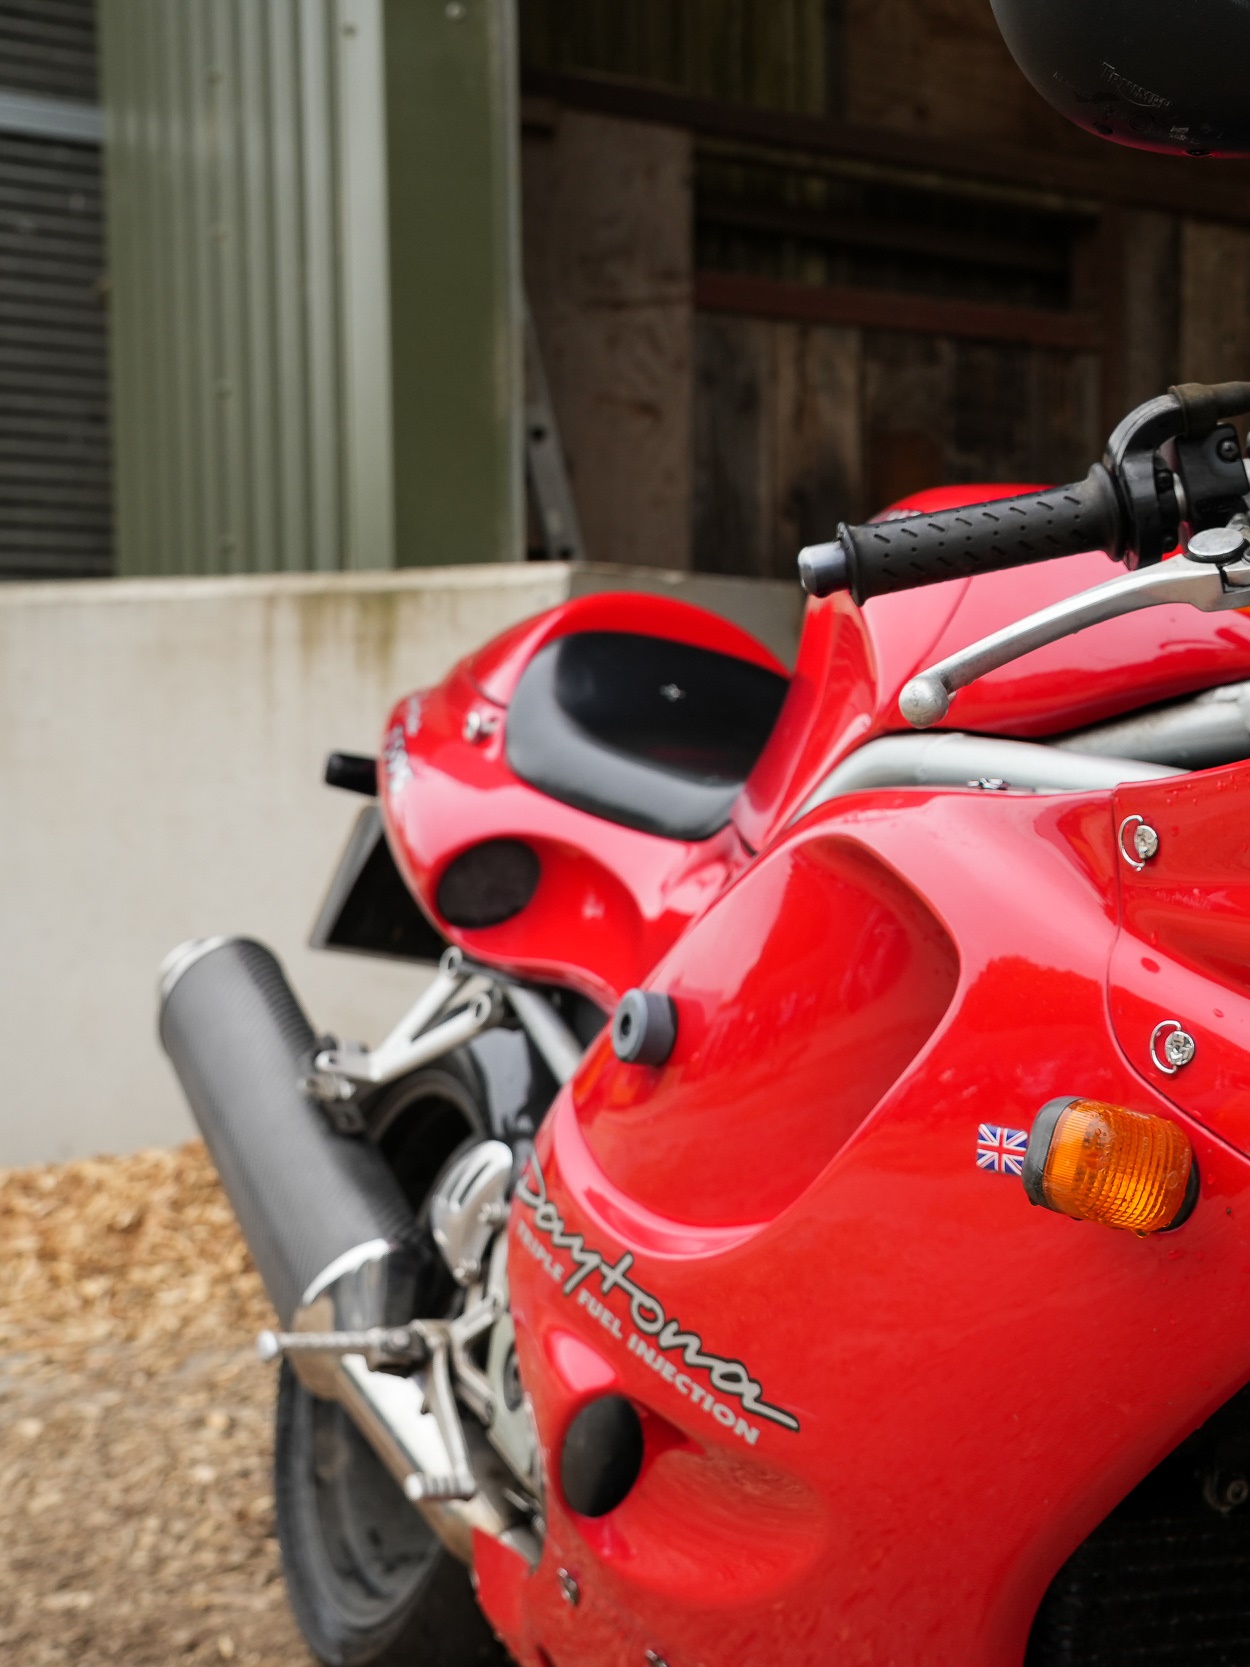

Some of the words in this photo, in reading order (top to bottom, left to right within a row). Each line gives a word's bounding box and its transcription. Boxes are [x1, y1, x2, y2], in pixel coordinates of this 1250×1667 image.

[516, 1150, 800, 1432] Daytona
[517, 1221, 565, 1283] TRIPLE
[576, 1288, 624, 1340] FUEL
[627, 1333, 761, 1445] INJECTION
